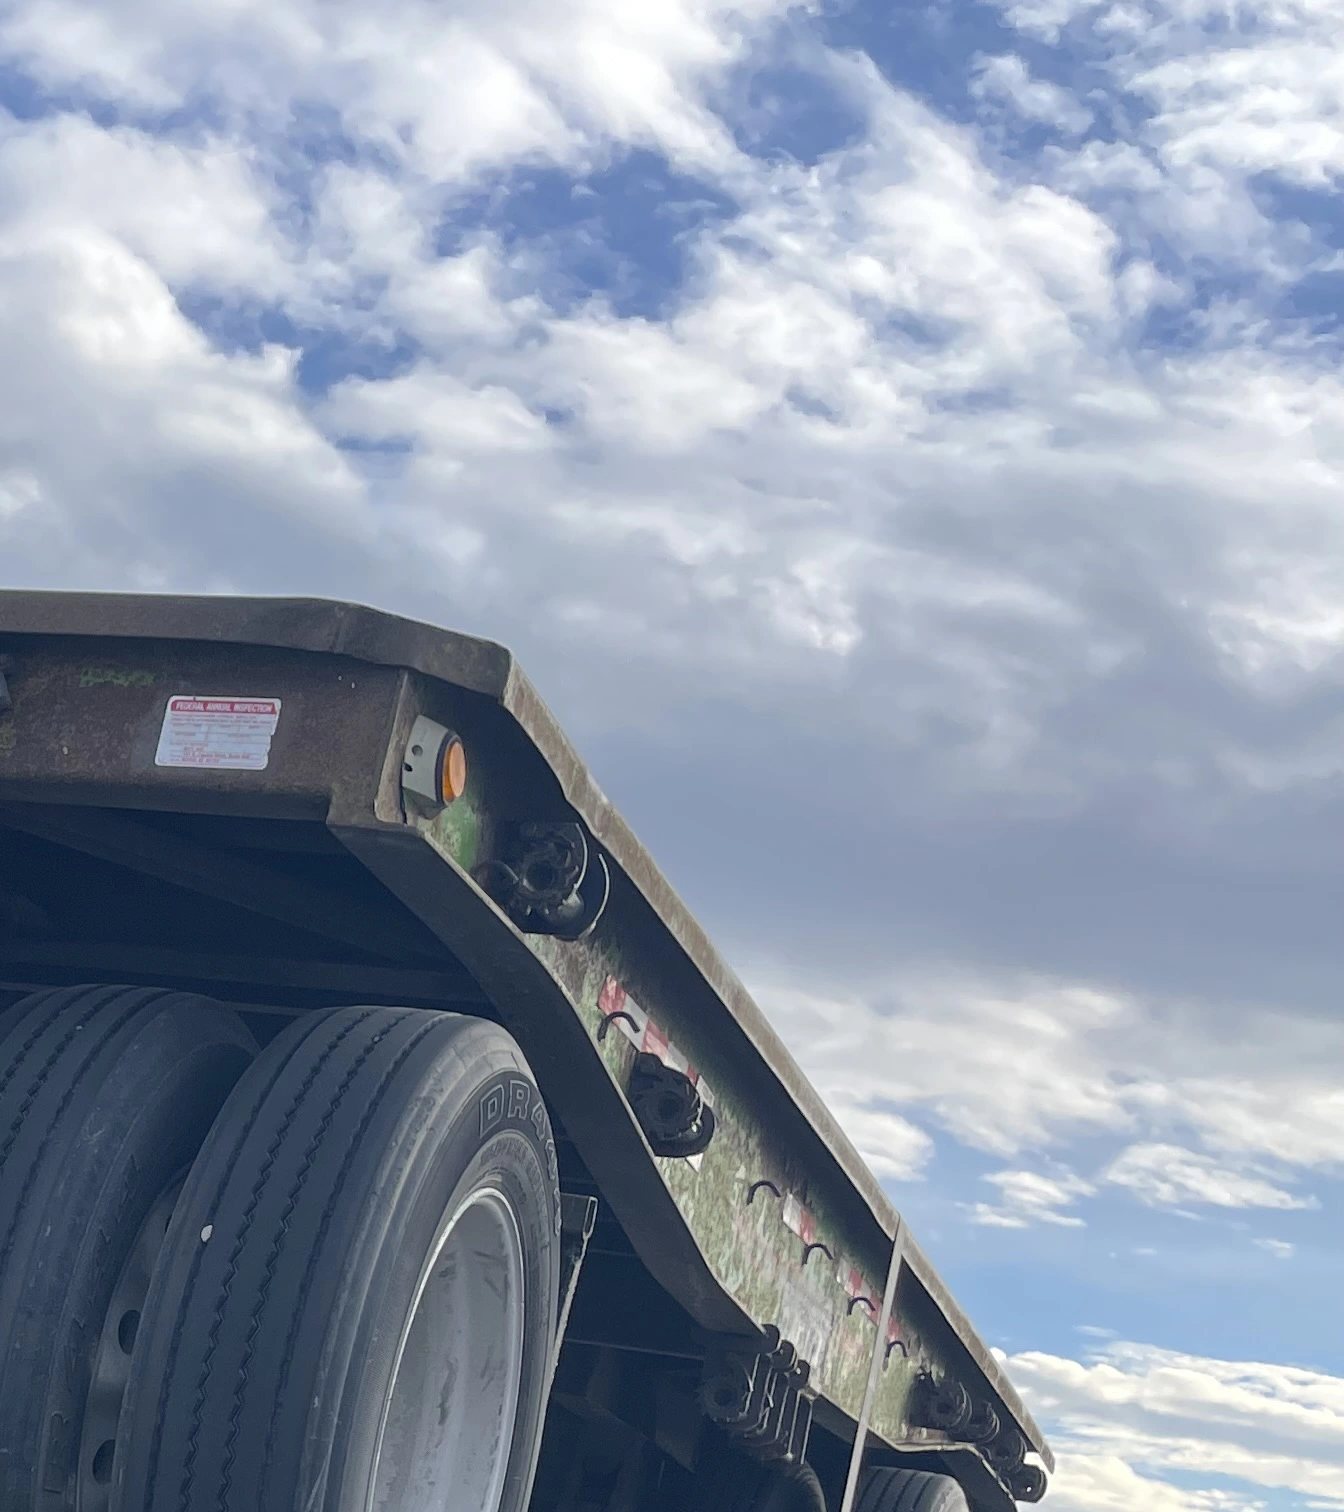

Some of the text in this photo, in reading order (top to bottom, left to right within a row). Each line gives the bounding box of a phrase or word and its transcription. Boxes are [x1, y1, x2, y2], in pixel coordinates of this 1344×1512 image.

[175, 702, 273, 712] FEDERAL ANNUAL INSPECTION
